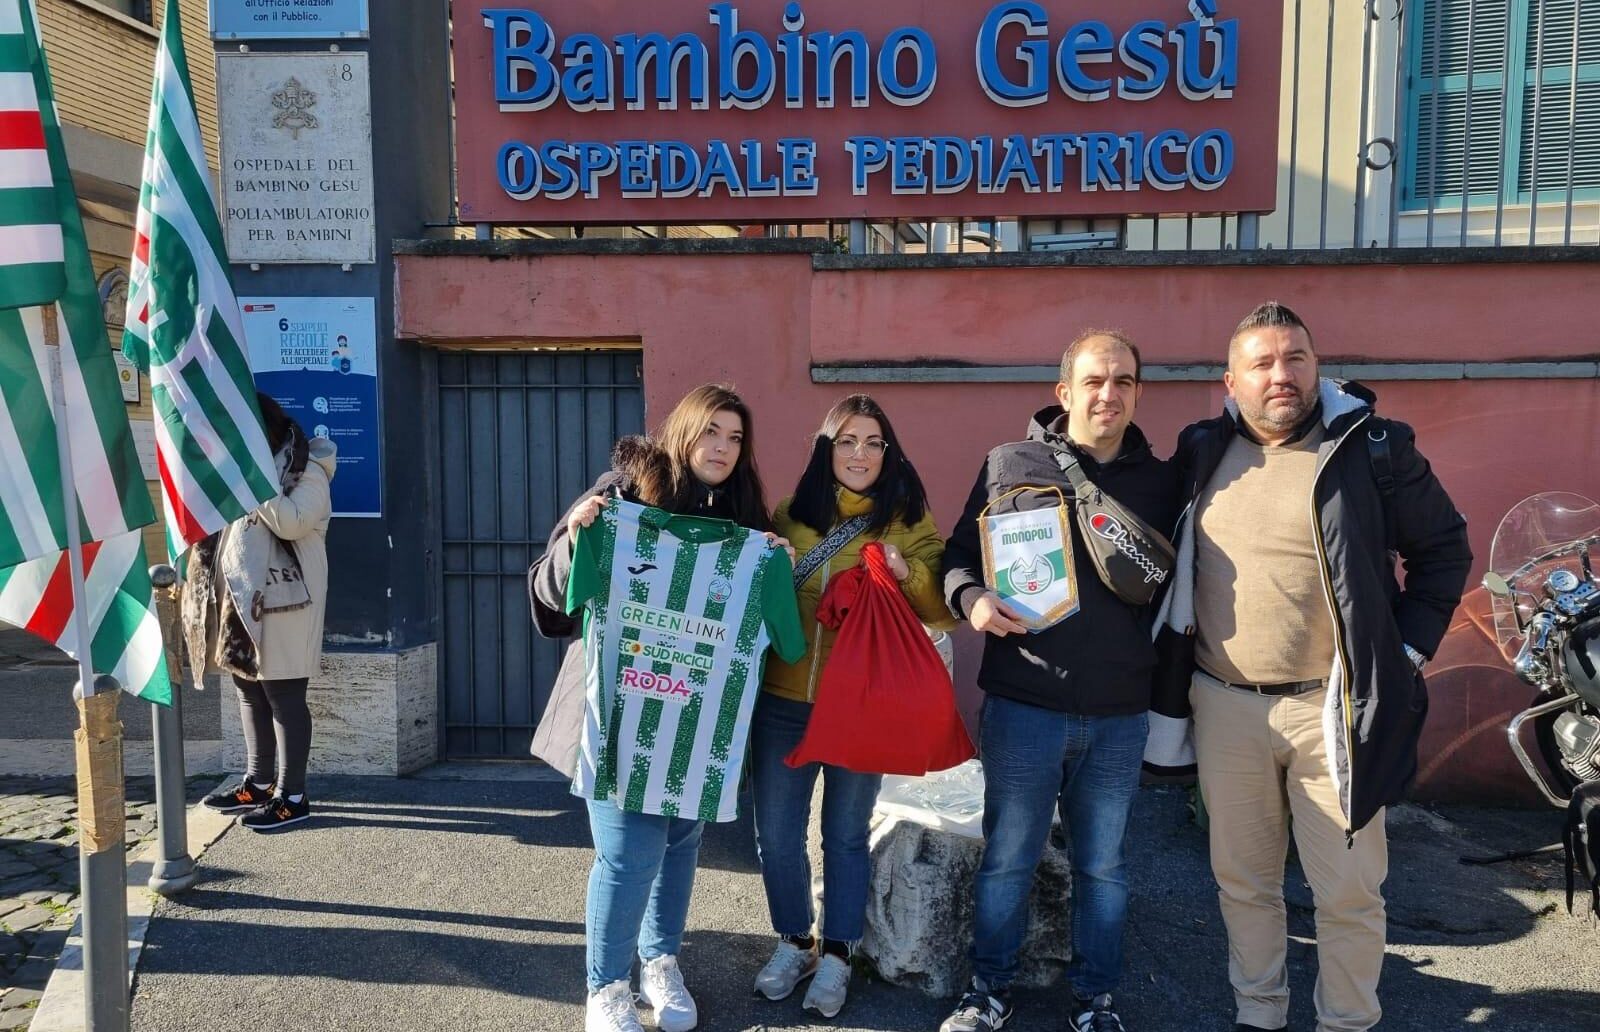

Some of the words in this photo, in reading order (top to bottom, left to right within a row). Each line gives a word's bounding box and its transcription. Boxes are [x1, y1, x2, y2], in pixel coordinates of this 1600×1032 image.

[253, 13, 268, 21] con
[272, 12, 278, 20] il
[281, 11, 322, 21] Pubblico.
[480, 1, 937, 111] Bambino
[976, 0, 1239, 107] Gesù
[341, 63, 353, 82] 8
[233, 159, 316, 171] OSPEDALE
[328, 159, 361, 171] DEL
[496, 138, 819, 200] OSPEDALE
[845, 129, 1234, 195] PEDIATRICO
[234, 180, 310, 192] BAMBINO
[228, 207, 370, 221] POLIAMBULATORIO
[248, 229, 276, 241] PER
[287, 229, 352, 241] BAMBINI
[278, 318, 289, 332] 6
[291, 321, 328, 332] SEMPLICI
[279, 333, 329, 347] REGOLE
[280, 348, 292, 356] PER
[294, 348, 328, 356] ACCEDERE
[1001, 527, 1053, 546] MONOPOLI
[620, 606, 681, 631] GREEN
[685, 619, 726, 641] LINK
[643, 645, 670, 660] SUD
[671, 651, 714, 669] RICICLI
[623, 668, 691, 697] RODA
